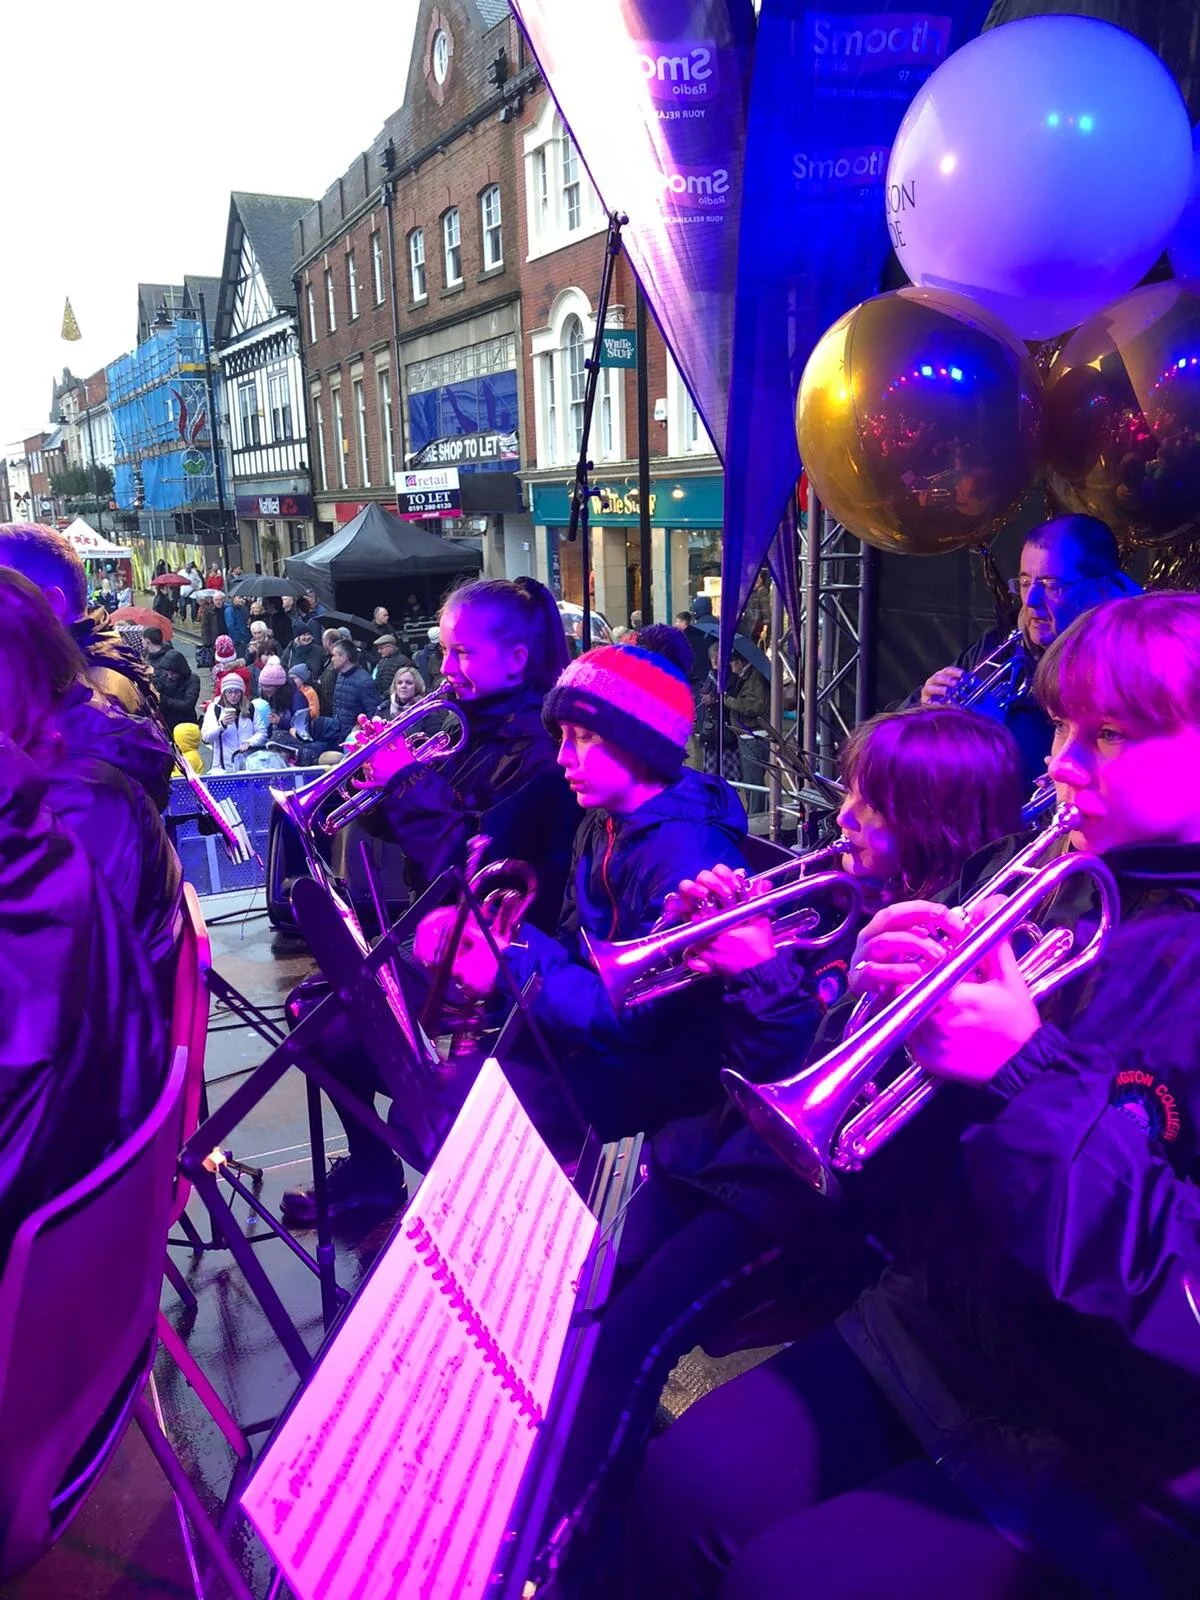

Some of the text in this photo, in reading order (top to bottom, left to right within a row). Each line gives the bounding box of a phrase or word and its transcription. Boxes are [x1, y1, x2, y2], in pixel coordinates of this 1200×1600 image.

[812, 19, 941, 57] Smooth
[438, 440, 463, 461] SHOP
[464, 438, 478, 459] TO
[479, 435, 499, 456] LET
[406, 491, 451, 505] TO LET
